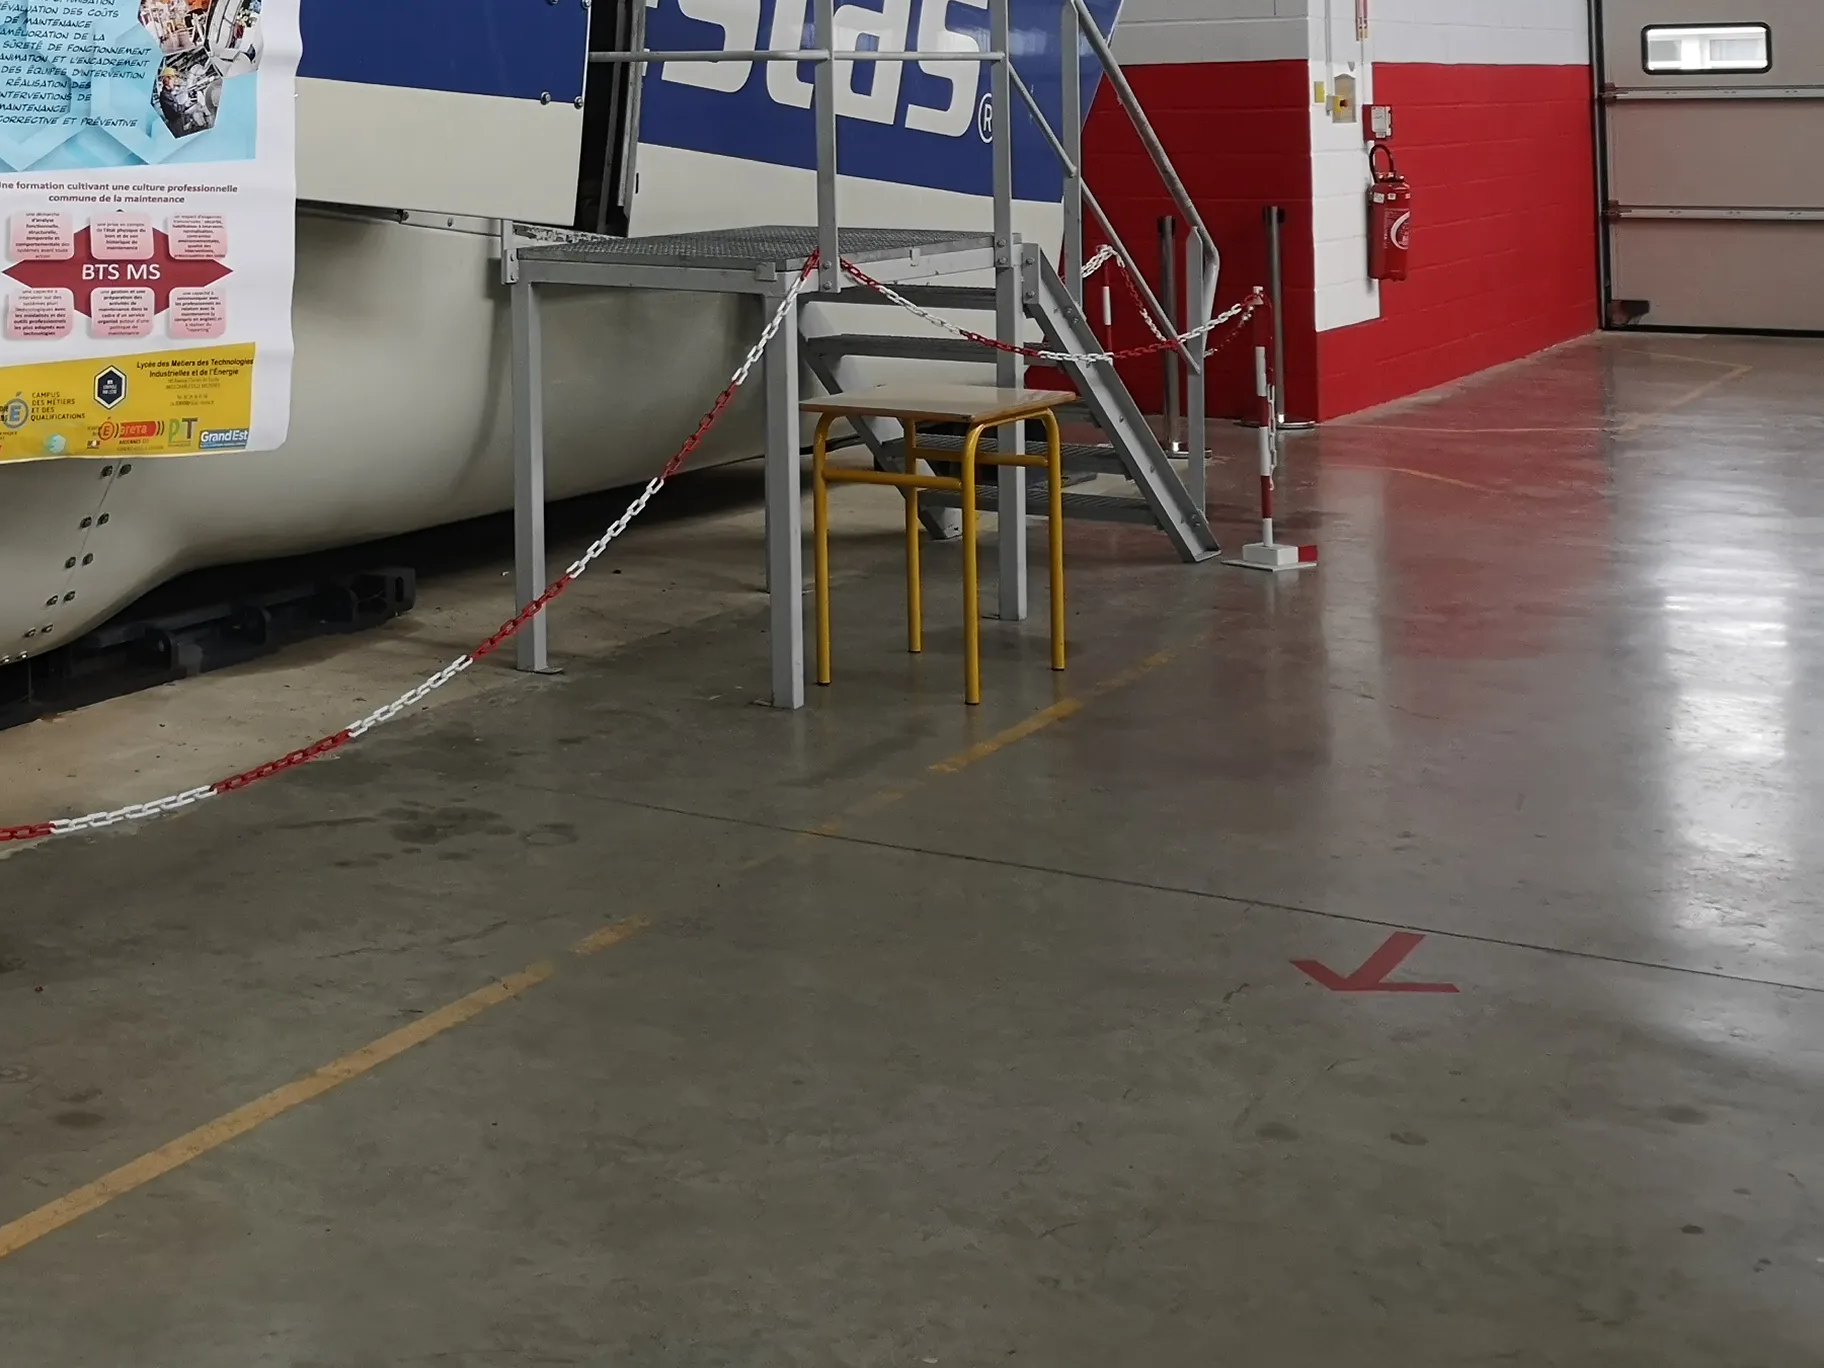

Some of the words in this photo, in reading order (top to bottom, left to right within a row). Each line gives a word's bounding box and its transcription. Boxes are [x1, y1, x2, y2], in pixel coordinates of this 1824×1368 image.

[4, 16, 20, 24] DE
[25, 18, 93, 28] MAINTENANCE
[81, 117, 139, 127] PRÉVENTIVE
[16, 182, 65, 191] formation
[67, 182, 110, 192] cultivant
[132, 183, 164, 192] culture
[167, 184, 238, 194] professionnelle
[99, 194, 111, 203] de
[113, 194, 123, 203] la
[125, 196, 185, 204] maintenance
[83, 264, 120, 281] BTS
[127, 264, 161, 280] MS
[137, 361, 156, 369] Lycée
